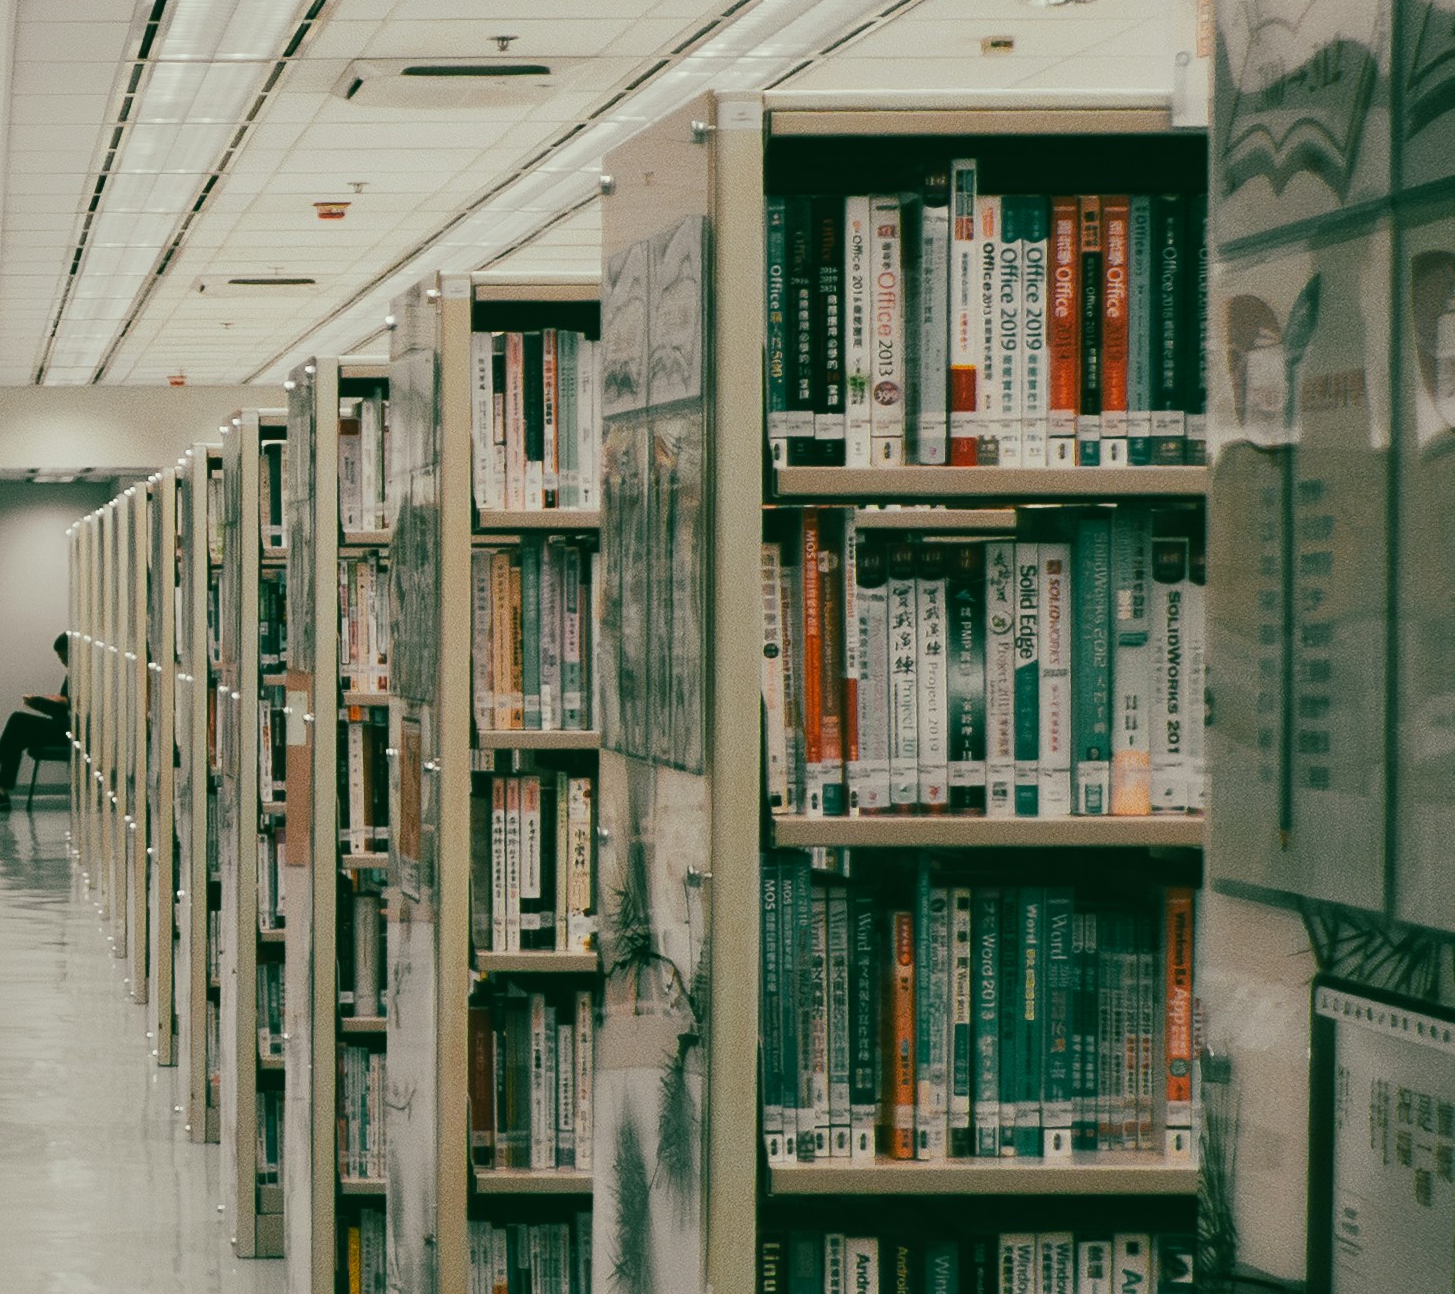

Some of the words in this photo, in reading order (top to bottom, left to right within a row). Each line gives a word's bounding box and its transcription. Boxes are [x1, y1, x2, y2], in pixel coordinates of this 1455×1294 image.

[853, 236, 862, 271] Office
[983, 243, 994, 291] Office
[1026, 247, 1042, 303] Office
[1162, 247, 1177, 292] Office
[771, 265, 781, 309] Office
[1001, 248, 1017, 303] Office
[1055, 267, 1071, 318] Office
[1107, 267, 1123, 318] Office
[877, 271, 896, 336] Office
[1002, 308, 1017, 351] 2019
[1027, 308, 1042, 350] 2019
[878, 339, 893, 377] 2013
[806, 530, 815, 559] MOS
[1019, 565, 1036, 609] Solid
[961, 621, 972, 648] PMP
[1017, 614, 1035, 660] Edge
[927, 662, 938, 712] Project
[765, 880, 776, 910] MOS
[783, 880, 792, 905] MOS
[857, 913, 871, 951] Word
[1025, 904, 1038, 943] Word
[1051, 915, 1068, 960] Word
[981, 934, 994, 976] Word
[981, 979, 995, 1020] 2013
